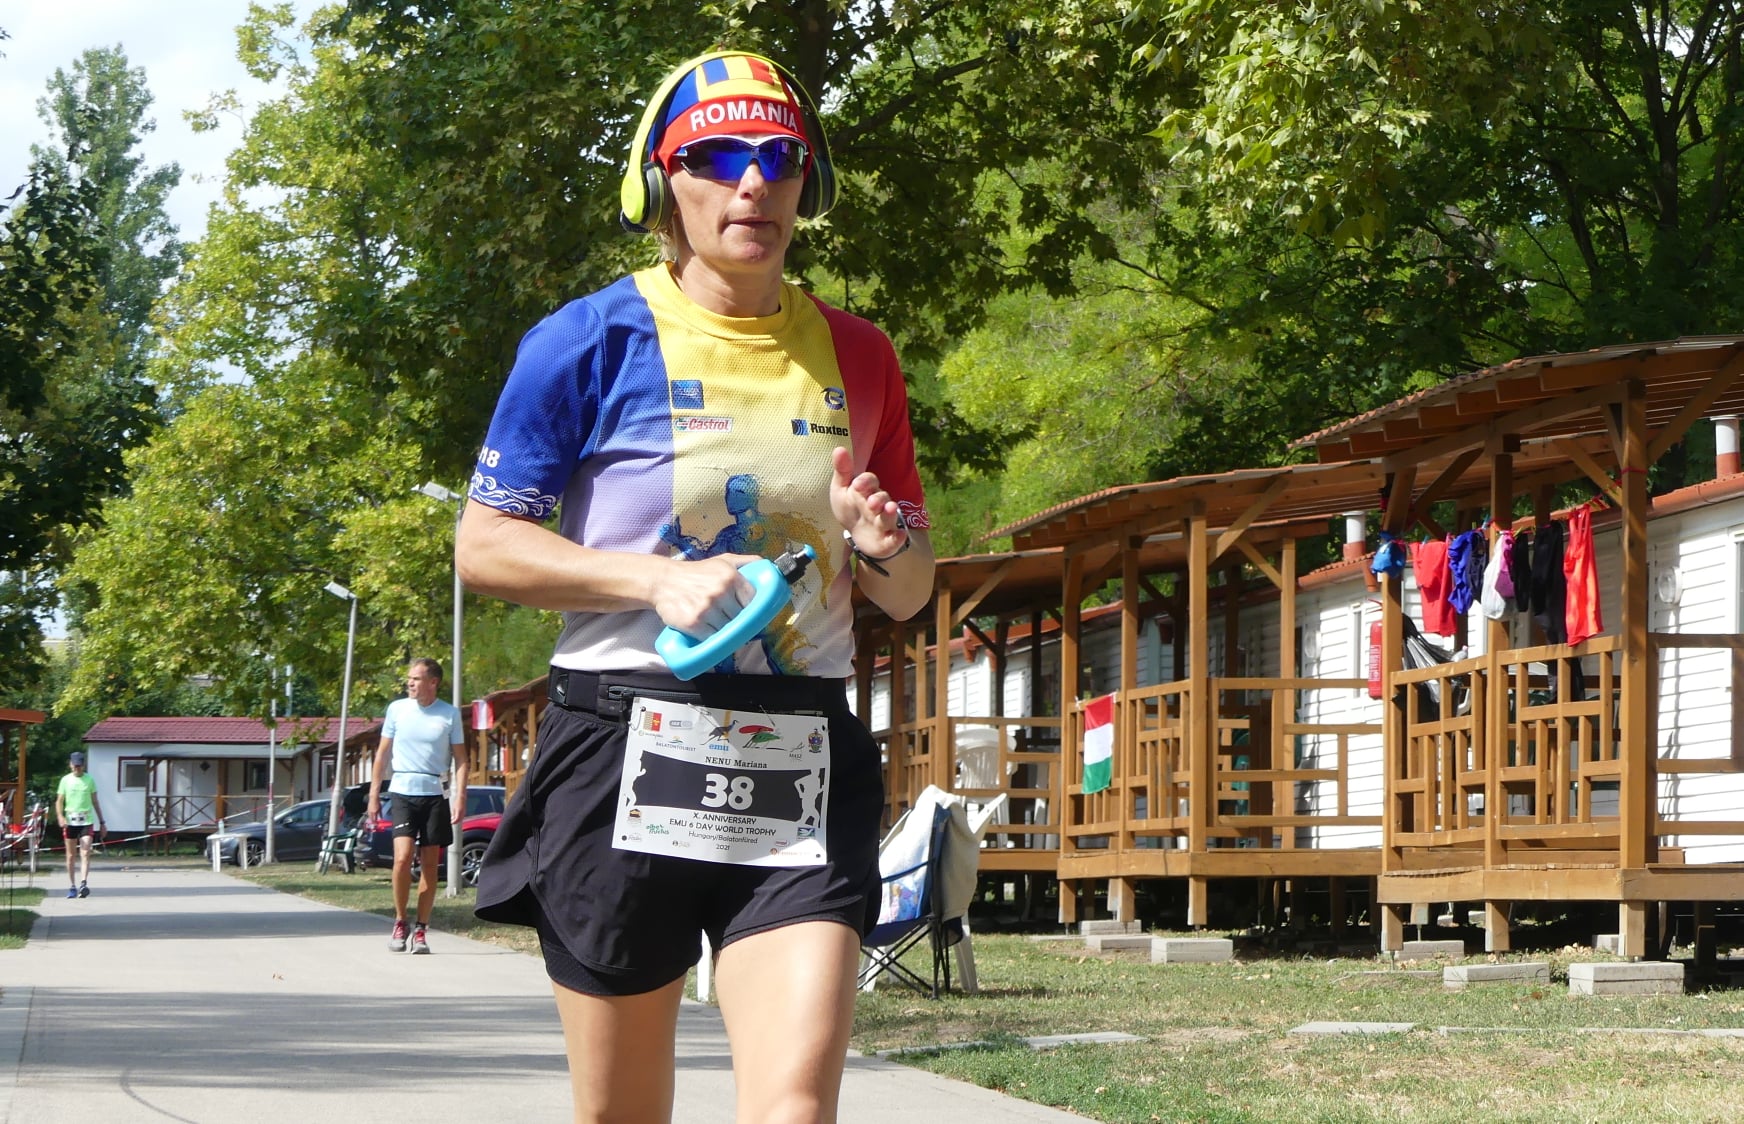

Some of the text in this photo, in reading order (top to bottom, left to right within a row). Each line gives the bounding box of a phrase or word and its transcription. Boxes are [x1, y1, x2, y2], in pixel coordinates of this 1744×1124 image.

[690, 100, 798, 132] ROMANIA
[689, 418, 729, 430] Castrol
[810, 423, 849, 436] Roxtec
[705, 756, 768, 769] NENU Mariana
[700, 773, 755, 810] 38
[702, 813, 757, 825] ANNIVERSARY
[669, 818, 687, 827] EMU
[696, 822, 714, 831] DAY
[715, 824, 744, 834] WORLD
[746, 827, 777, 836] TROPHY
